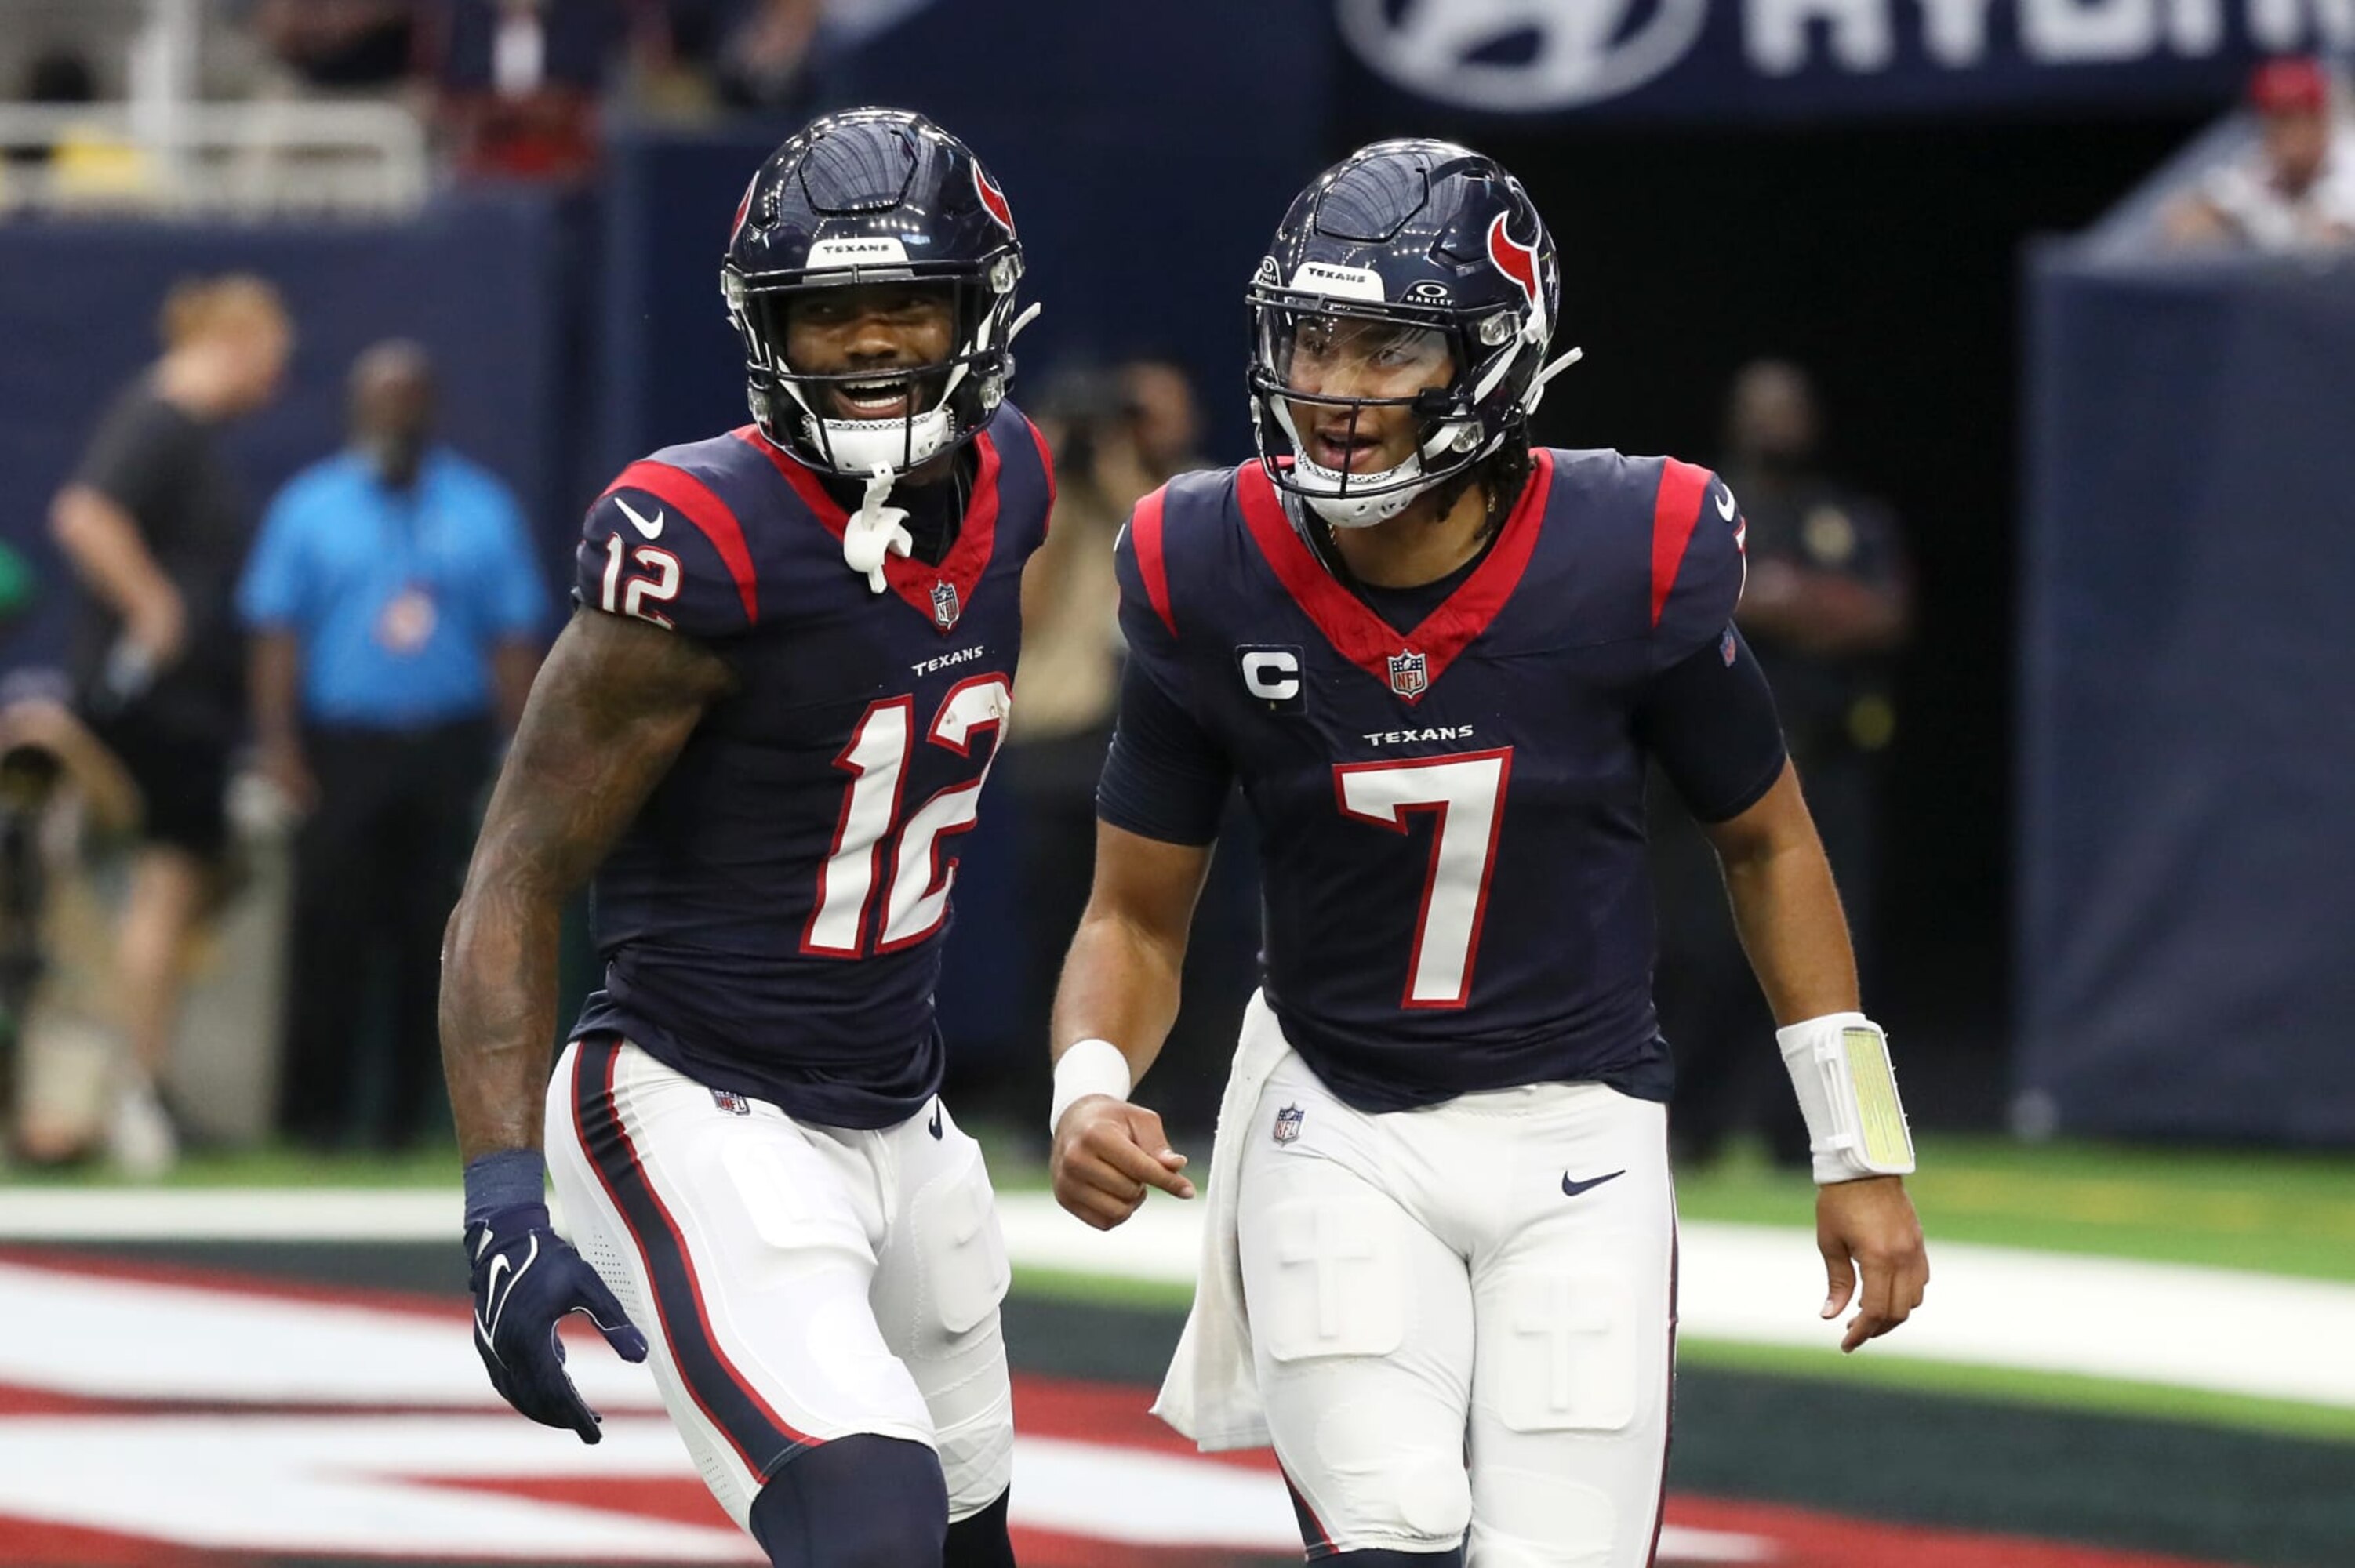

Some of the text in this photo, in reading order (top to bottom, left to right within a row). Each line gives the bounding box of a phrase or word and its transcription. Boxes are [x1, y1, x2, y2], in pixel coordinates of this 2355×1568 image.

[823, 244, 890, 254] TEXANS
[1308, 267, 1366, 283] TEXANS
[1407, 295, 1455, 306] OAKLEY
[599, 532, 684, 630] 12
[911, 645, 985, 677] TEXANS
[1242, 652, 1299, 699] C
[1396, 671, 1422, 689] NFL
[1363, 724, 1474, 746] TEXANS
[799, 671, 1015, 960] 12
[1332, 746, 1514, 1010] 7
